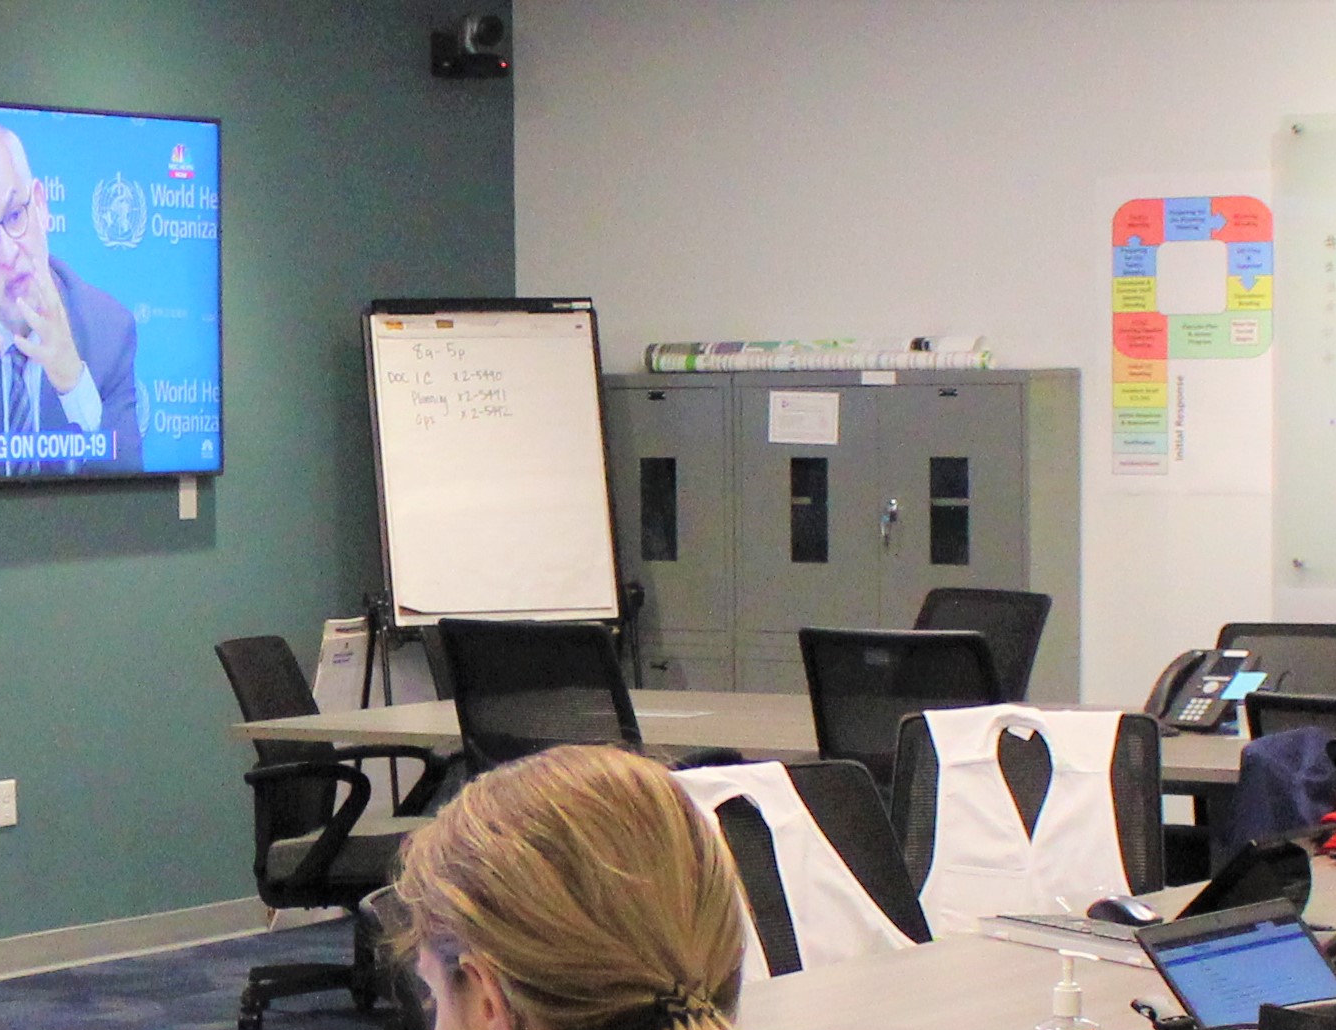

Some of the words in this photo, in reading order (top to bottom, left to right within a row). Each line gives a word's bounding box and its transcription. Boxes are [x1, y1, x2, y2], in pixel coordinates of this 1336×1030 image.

[150, 183, 195, 209] World
[151, 212, 218, 245] Organiza
[154, 379, 198, 403] World
[154, 409, 219, 440] Organiza
[10, 434, 34, 459] ON
[37, 433, 106, 458] COVID-19
